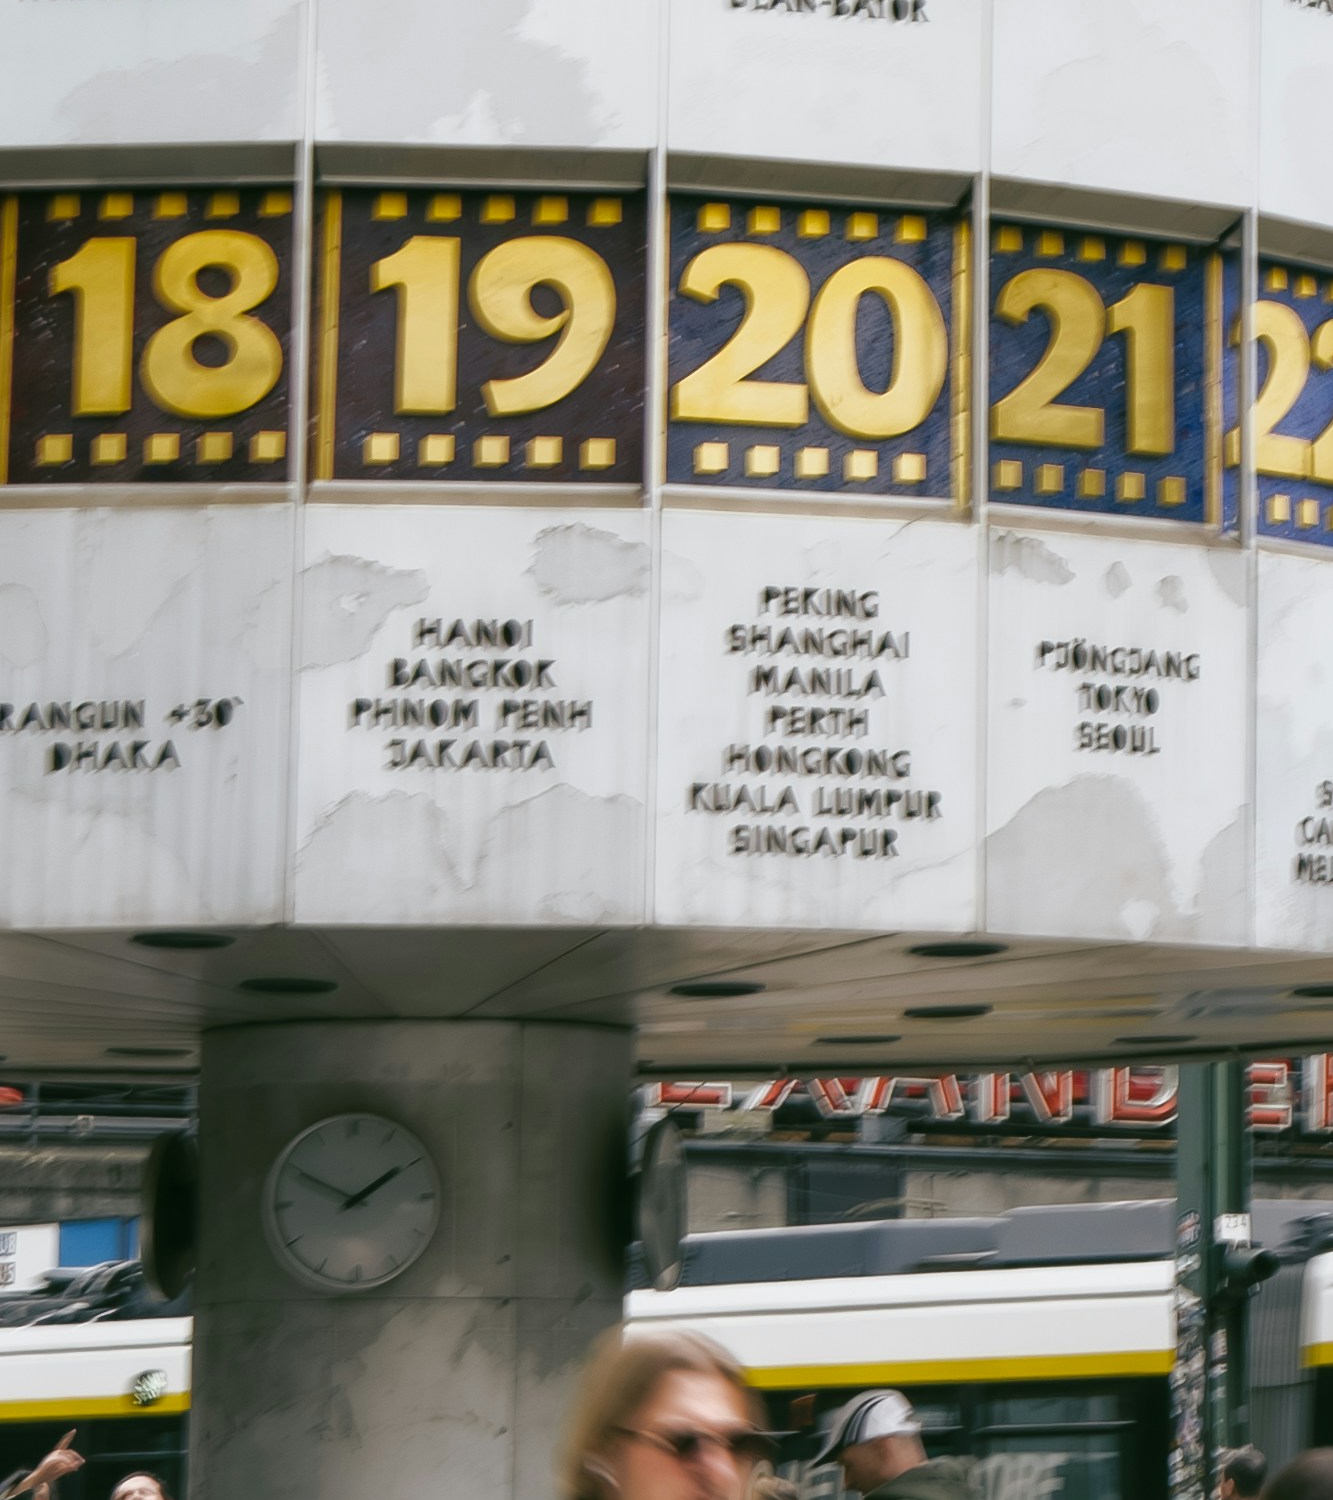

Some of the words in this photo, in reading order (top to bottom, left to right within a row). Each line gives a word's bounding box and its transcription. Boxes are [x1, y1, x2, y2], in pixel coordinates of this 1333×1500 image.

[50, 229, 284, 421] 18
[370, 235, 618, 419] 19
[671, 243, 947, 440] 20
[991, 267, 1175, 457] 21
[757, 586, 879, 619] PEKING
[412, 618, 533, 649] HANOI
[723, 624, 910, 660] SHANGHAI
[386, 658, 557, 691] BANGKOK
[1033, 637, 1200, 681] PJÖNGJANG
[747, 665, 886, 698] MANILA
[347, 698, 479, 731] PHNOM
[494, 699, 593, 731] PENH
[1077, 682, 1159, 716] TOKYO
[0, 700, 146, 734] RANGUN
[764, 705, 869, 739] PERTH
[383, 739, 556, 771] JAKARTA
[1073, 721, 1161, 756] SEOUL
[43, 740, 181, 775] DHAKA
[721, 744, 911, 778] HONGKONG
[685, 783, 799, 815] KUALA
[812, 787, 943, 822] LUMPUR
[727, 825, 899, 859] SINGAPUR
